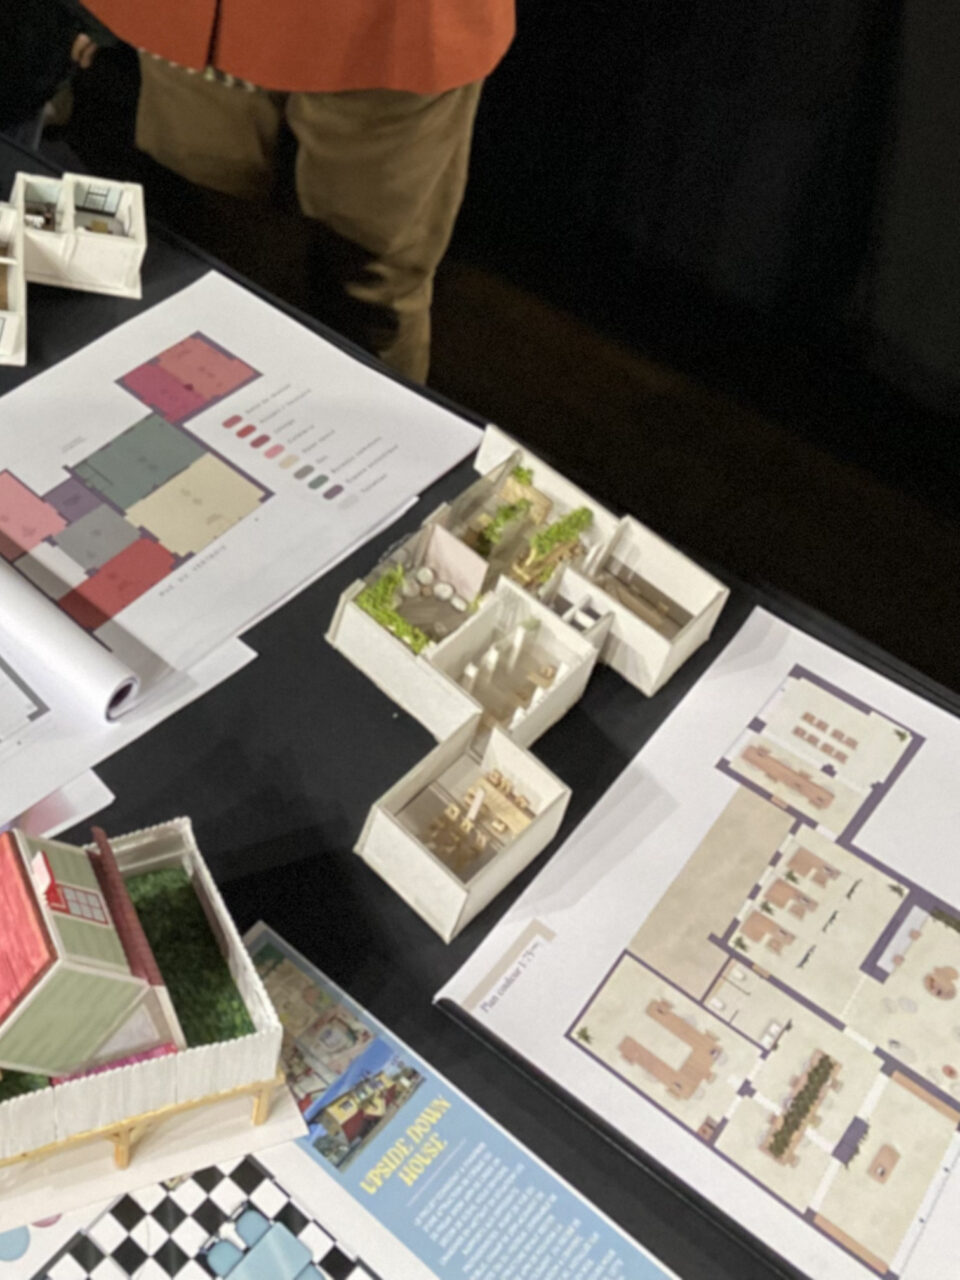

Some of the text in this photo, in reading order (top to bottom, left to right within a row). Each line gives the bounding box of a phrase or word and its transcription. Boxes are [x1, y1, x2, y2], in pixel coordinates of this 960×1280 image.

[359, 1096, 452, 1195] UPSIDE DOWN
[397, 1133, 447, 1187] HOUSE
